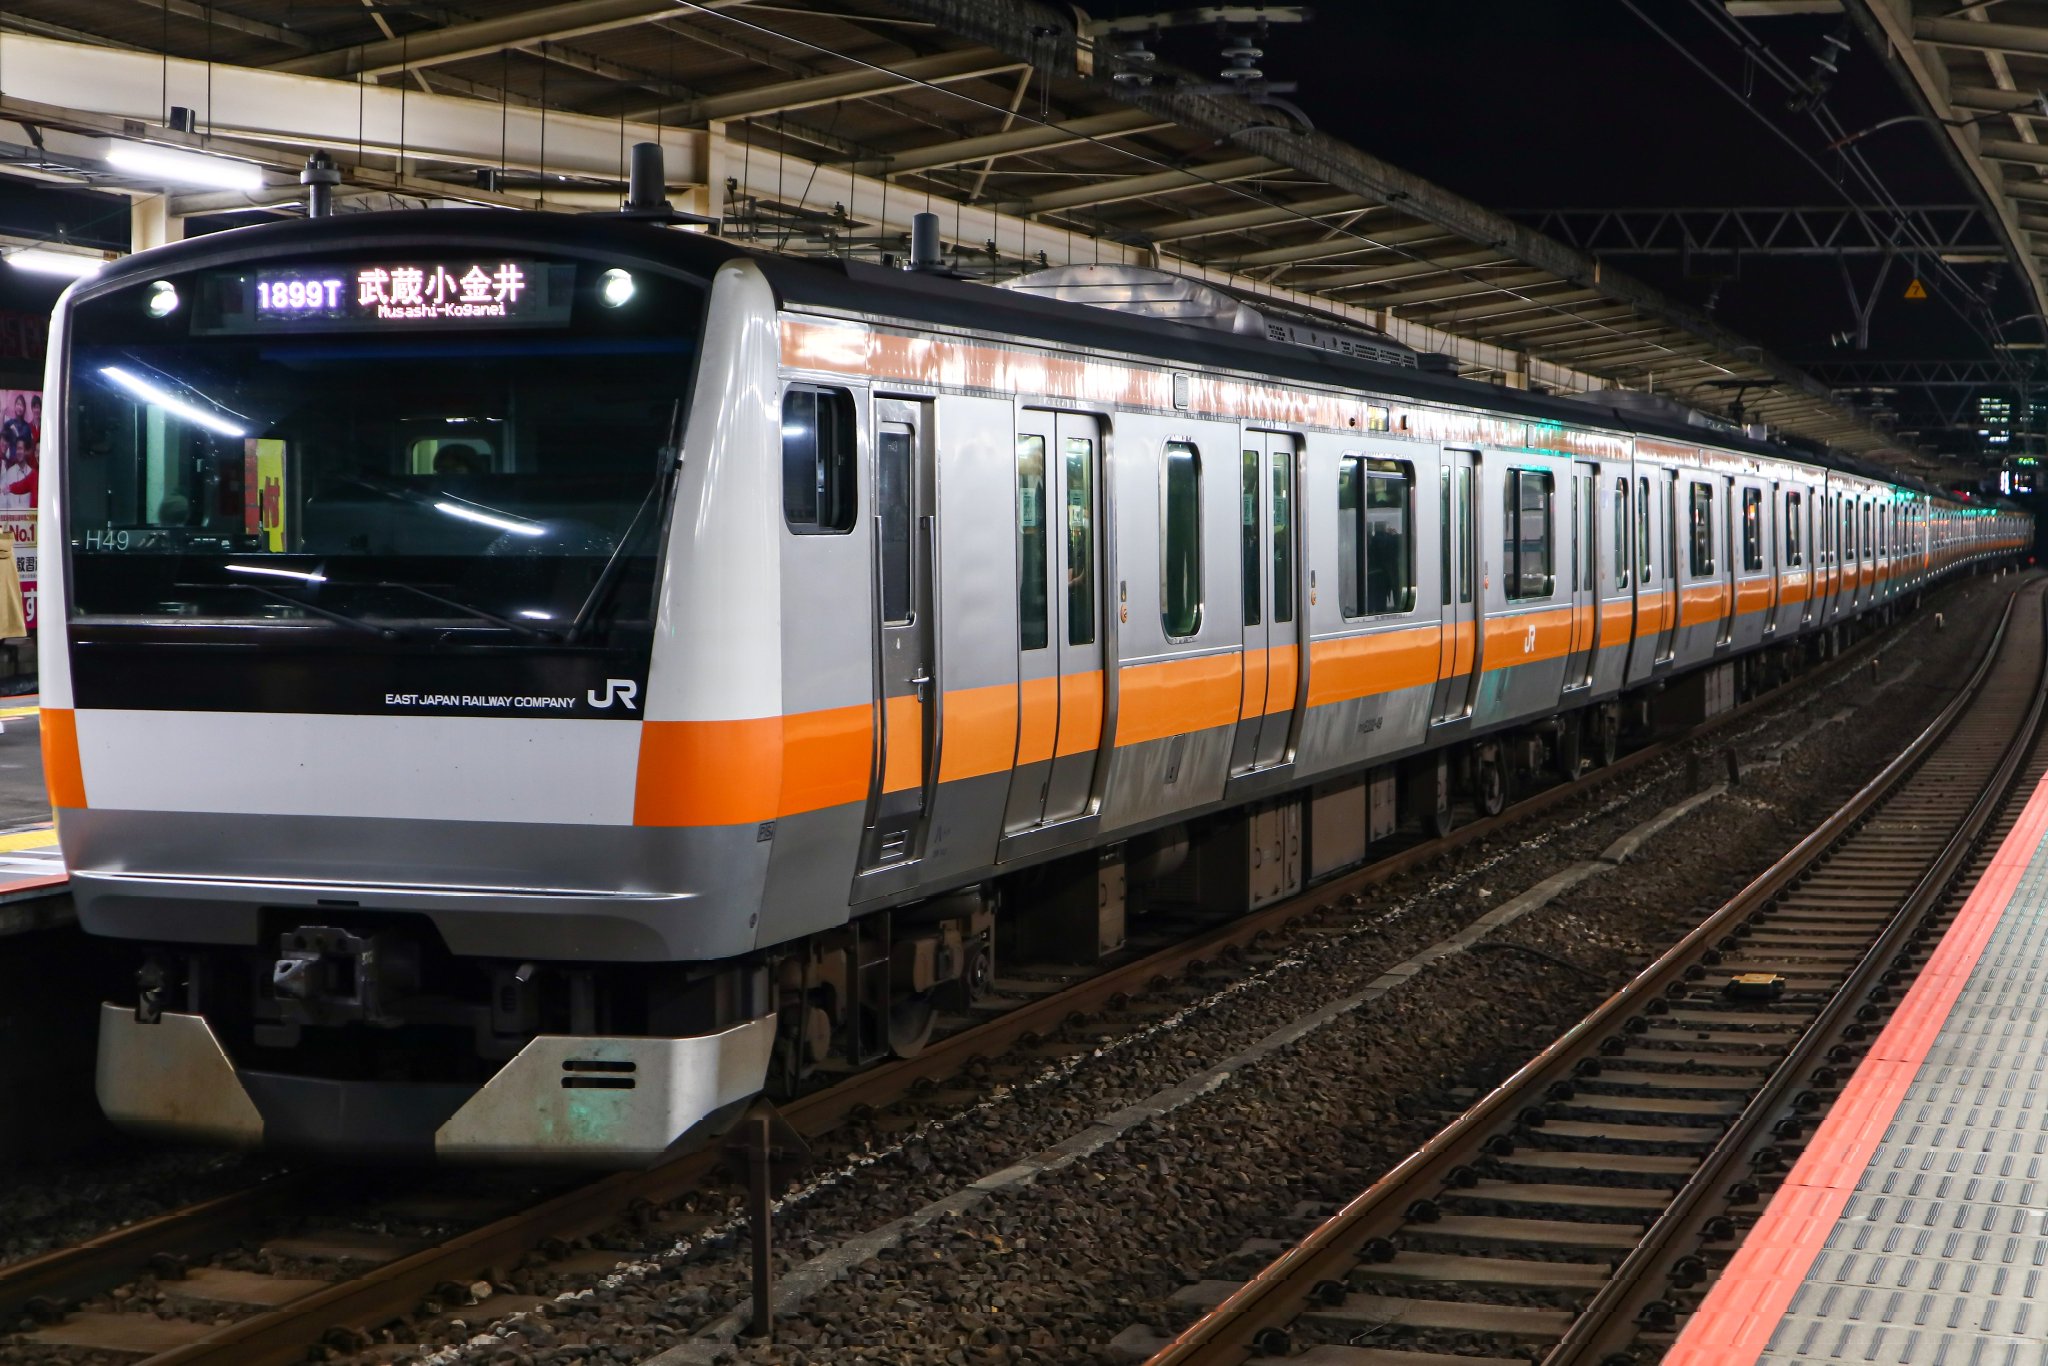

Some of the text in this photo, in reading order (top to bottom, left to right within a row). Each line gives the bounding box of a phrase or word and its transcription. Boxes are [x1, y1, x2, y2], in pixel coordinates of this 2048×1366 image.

[258, 279, 342, 309] 1899T
[358, 263, 525, 305] 武蔵小金井
[378, 302, 505, 319] Musashi-Koganei
[86, 530, 130, 550] H49
[16, 556, 38, 573] 教習
[1524, 624, 1536, 654] JR
[385, 693, 576, 709] EAST JAPAN RAILWAY COMPANY
[587, 678, 638, 710] JR
